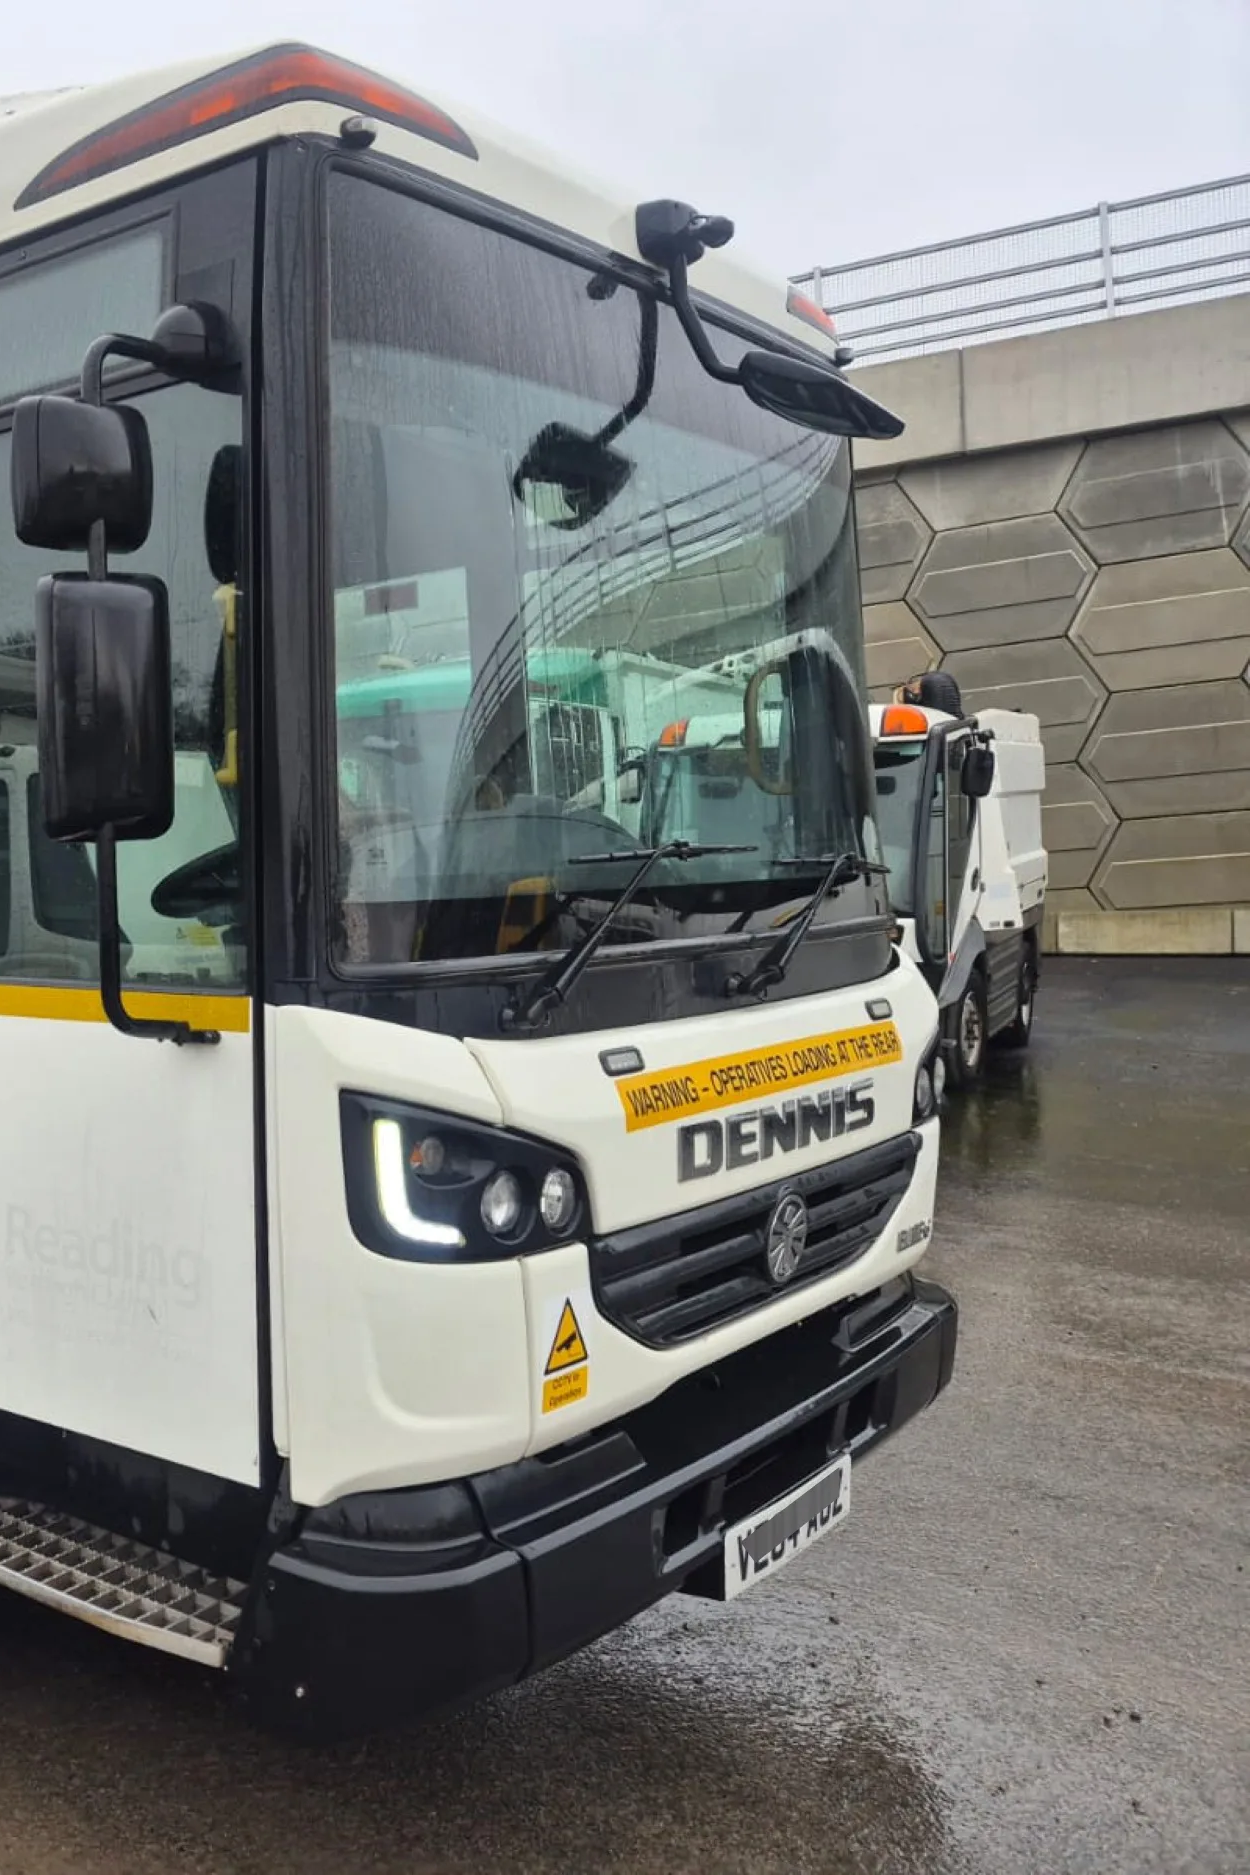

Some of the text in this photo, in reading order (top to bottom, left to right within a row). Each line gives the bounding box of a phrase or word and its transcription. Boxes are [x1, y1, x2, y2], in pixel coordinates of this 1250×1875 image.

[626, 1075, 700, 1118] WARNING
[710, 1055, 788, 1096] OPERATIVES
[785, 1043, 838, 1077] LOADING
[836, 1039, 851, 1064] AT
[848, 1035, 873, 1061] THE
[869, 1029, 900, 1057] REAR
[677, 1077, 874, 1184] DENNIS
[6, 1203, 203, 1310] Reading
